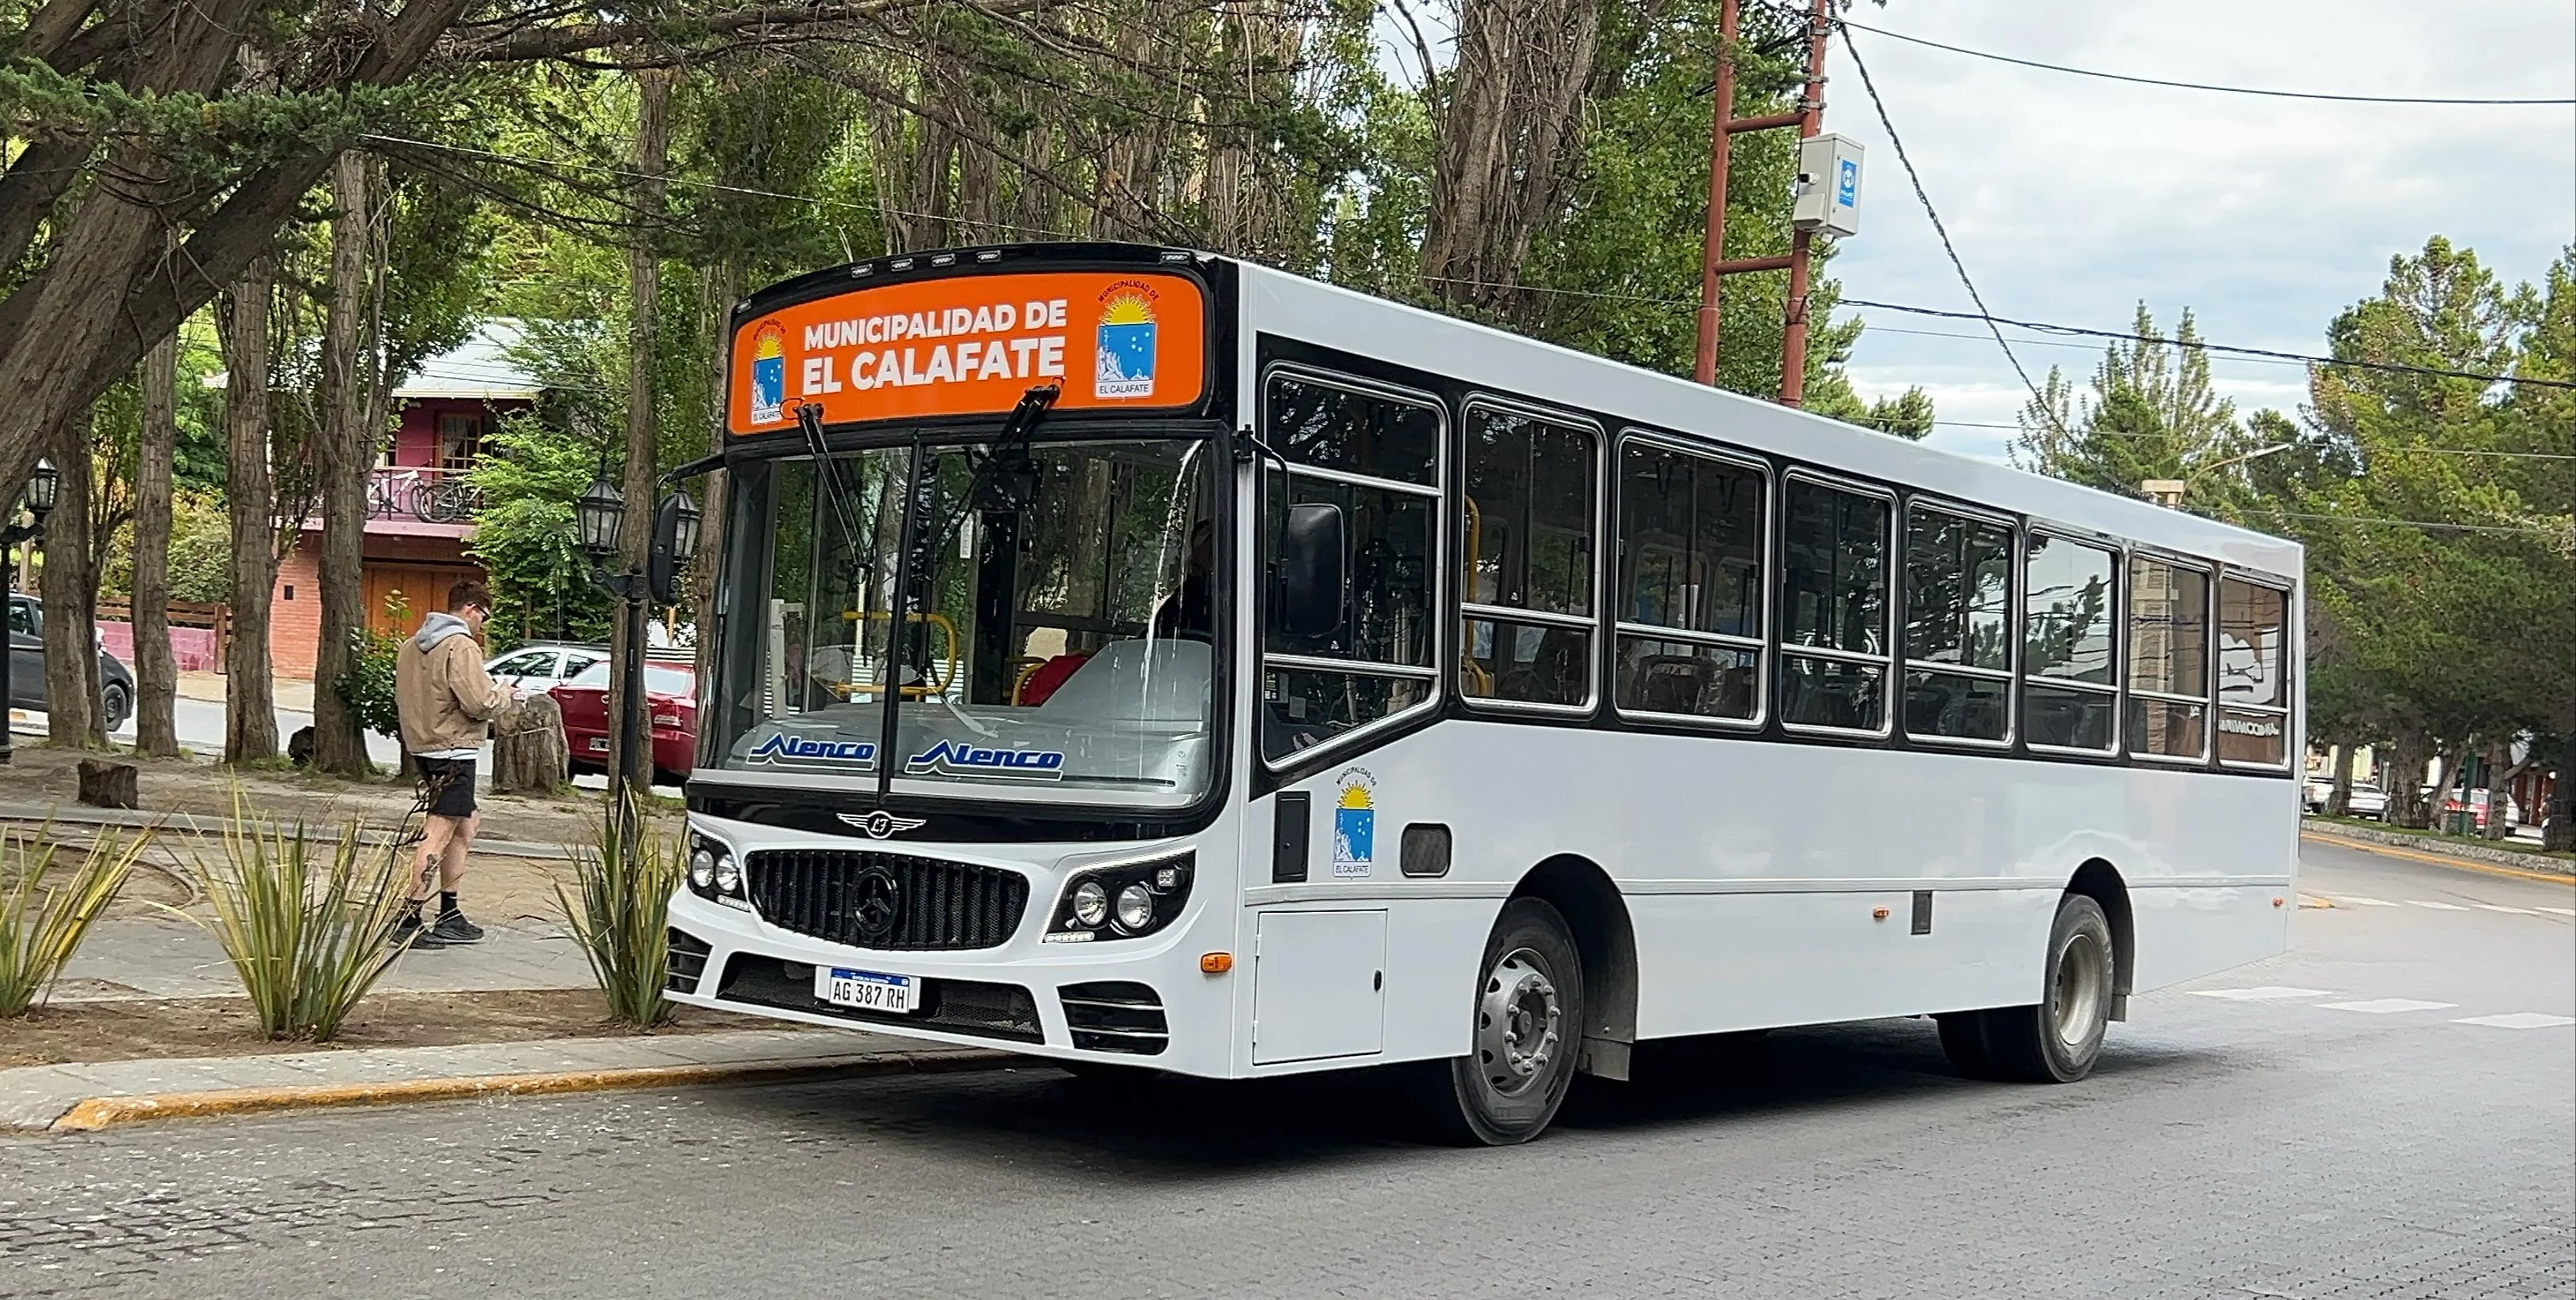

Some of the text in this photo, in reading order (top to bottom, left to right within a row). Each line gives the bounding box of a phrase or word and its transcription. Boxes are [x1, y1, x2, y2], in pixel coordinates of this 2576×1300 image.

[1098, 280, 1150, 302] MUNICIPALIDAD
[804, 303, 1016, 351] MUNICIPALIDAD
[1024, 299, 1068, 330] DE
[802, 336, 1065, 395] EL CALAFATE
[1110, 383, 1149, 394] CALAFATE
[1343, 865, 1369, 874] CALAFATE
[833, 981, 905, 1009] AG 387 RH
